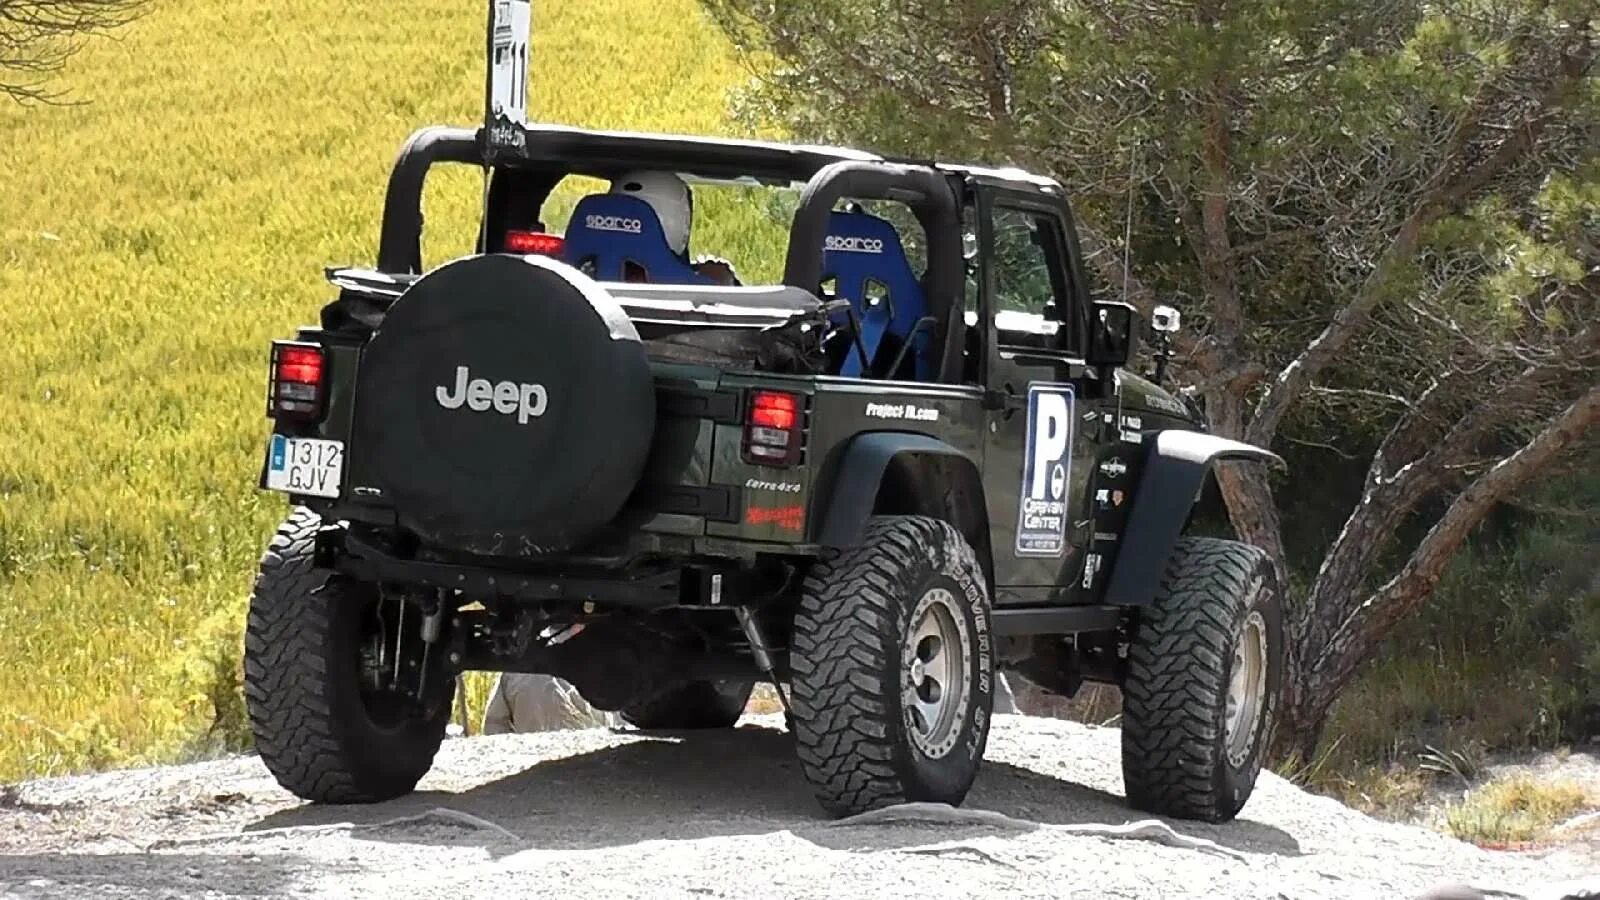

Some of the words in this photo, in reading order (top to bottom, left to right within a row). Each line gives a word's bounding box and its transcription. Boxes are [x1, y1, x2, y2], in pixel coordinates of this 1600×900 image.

[586, 214, 641, 231] sparco
[825, 235, 882, 251] sparco
[436, 366, 547, 424] Jeep
[289, 440, 339, 468] 1312
[289, 466, 328, 491] GJV
